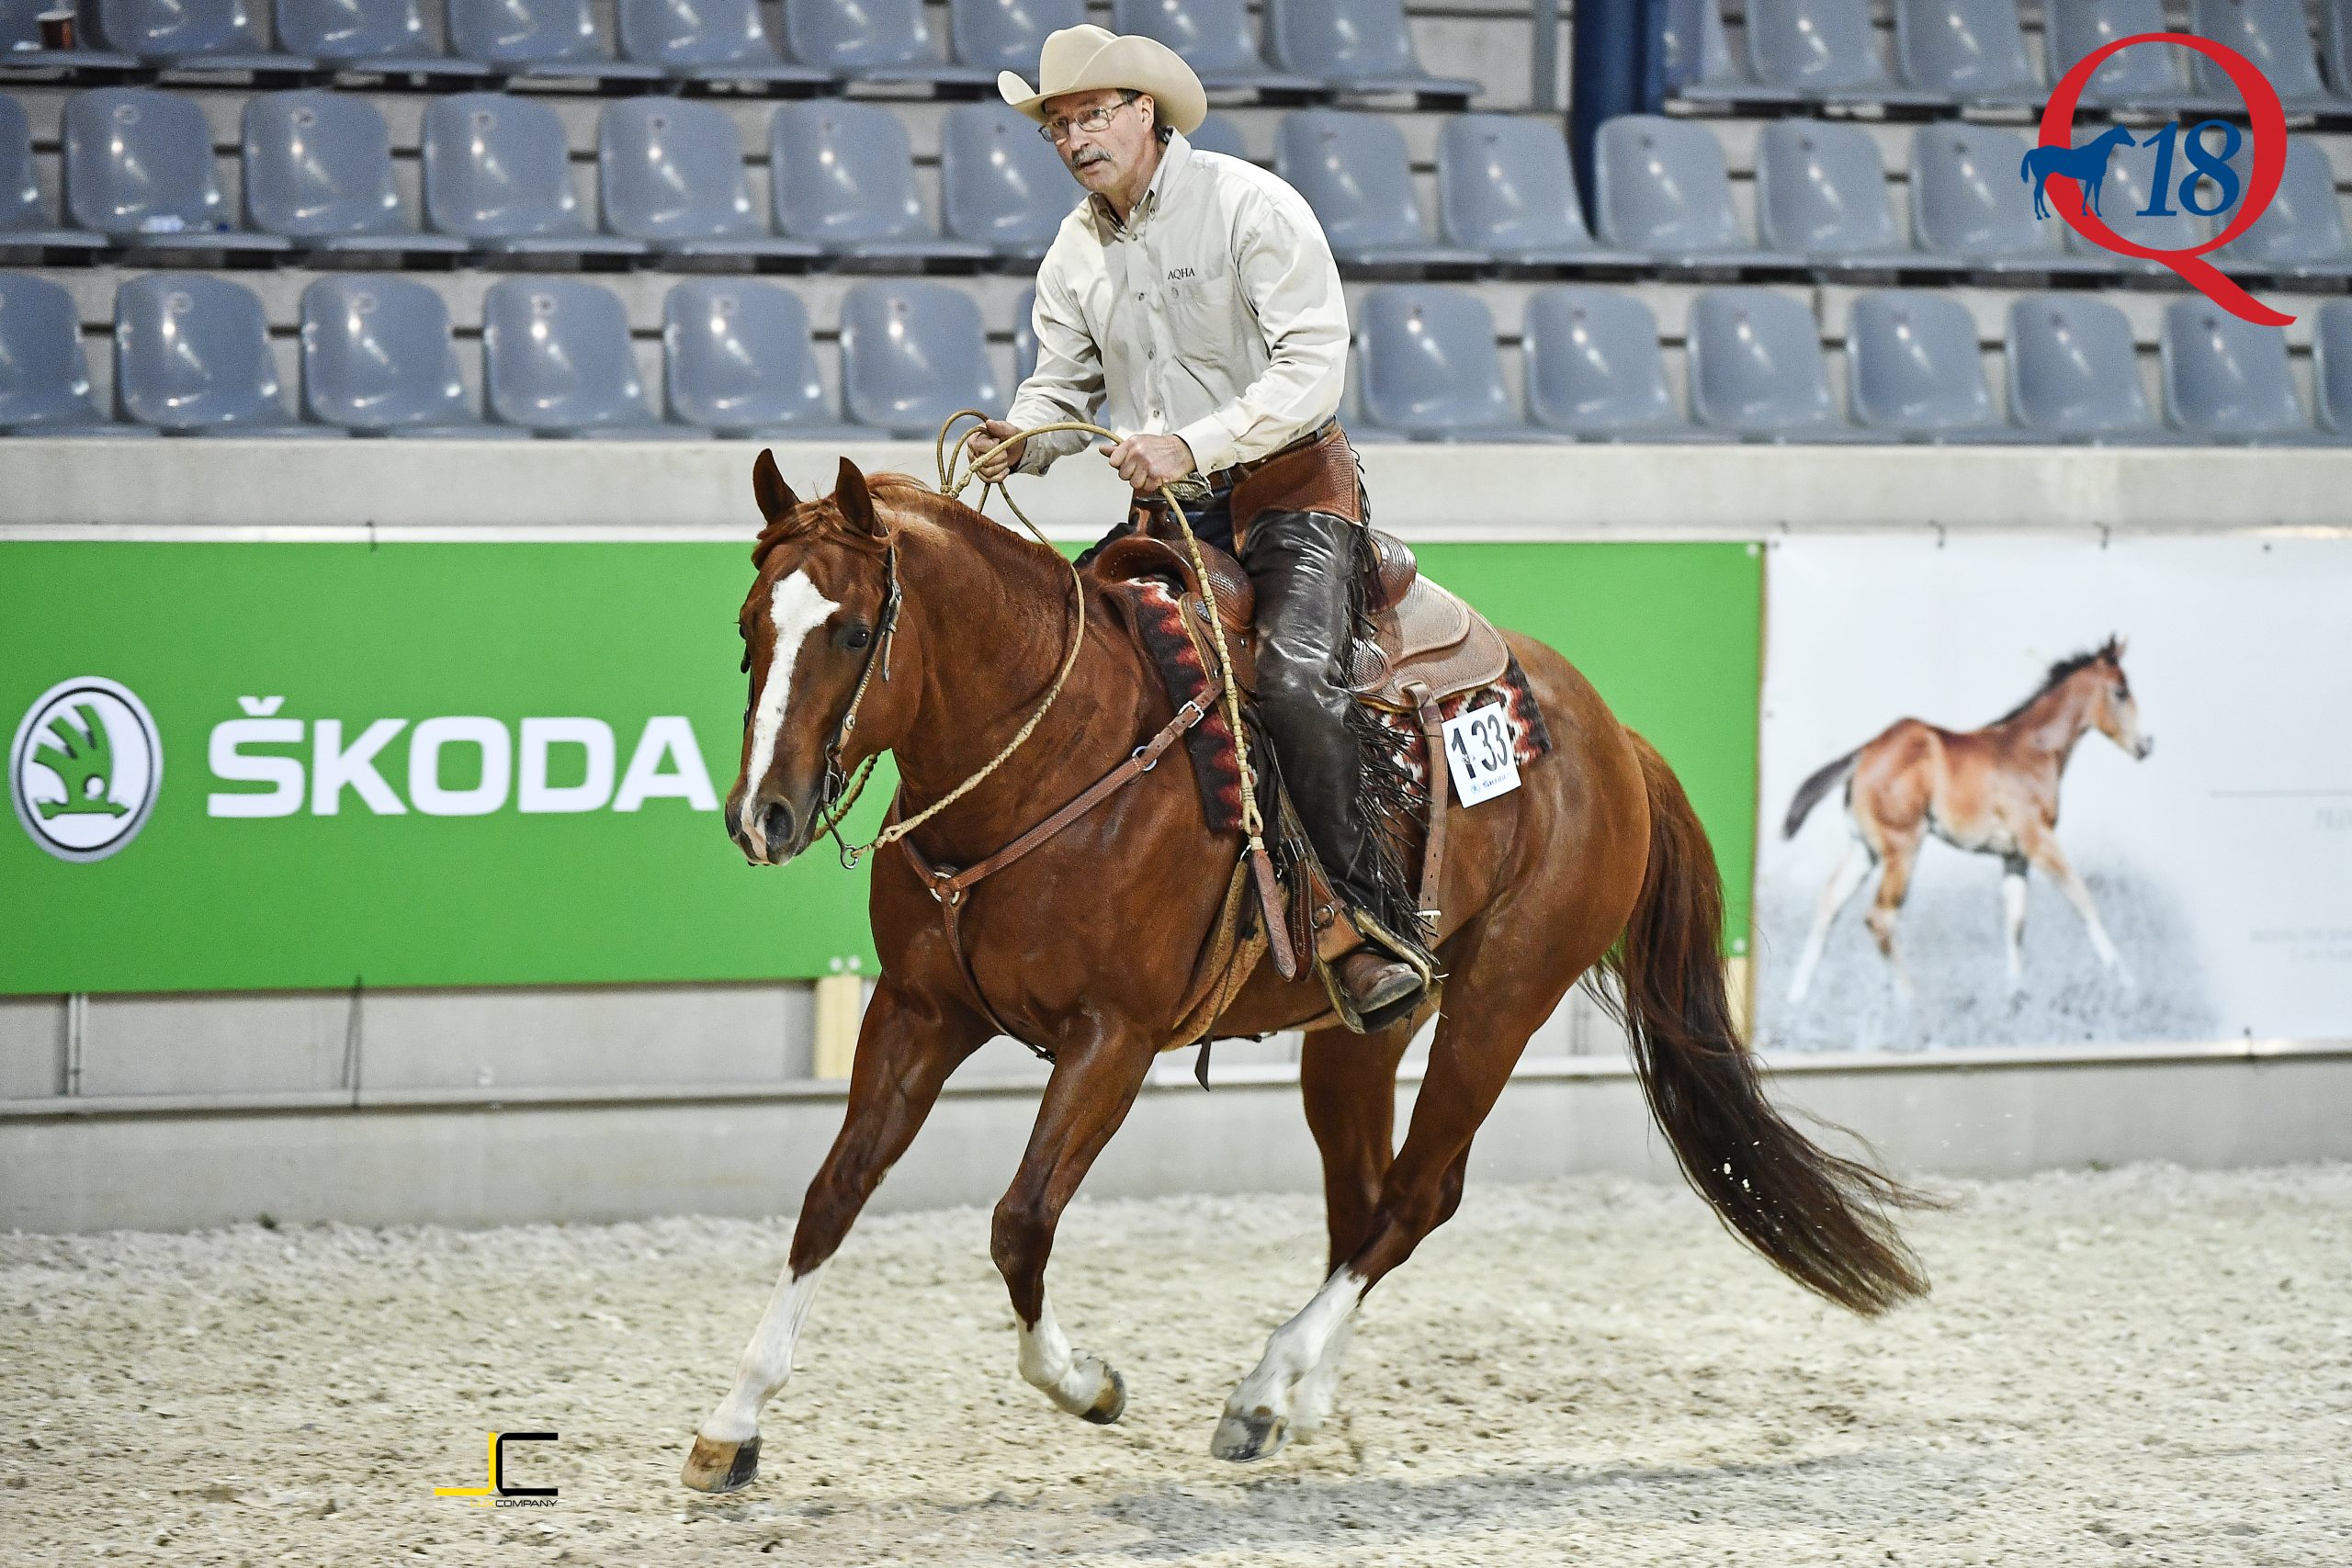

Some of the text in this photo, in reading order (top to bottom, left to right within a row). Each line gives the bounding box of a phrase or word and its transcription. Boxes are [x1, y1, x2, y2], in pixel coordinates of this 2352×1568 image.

[1168, 267, 1195, 279] AQHA
[208, 696, 719, 818] ŠKODA
[1452, 714, 1508, 780] 133
